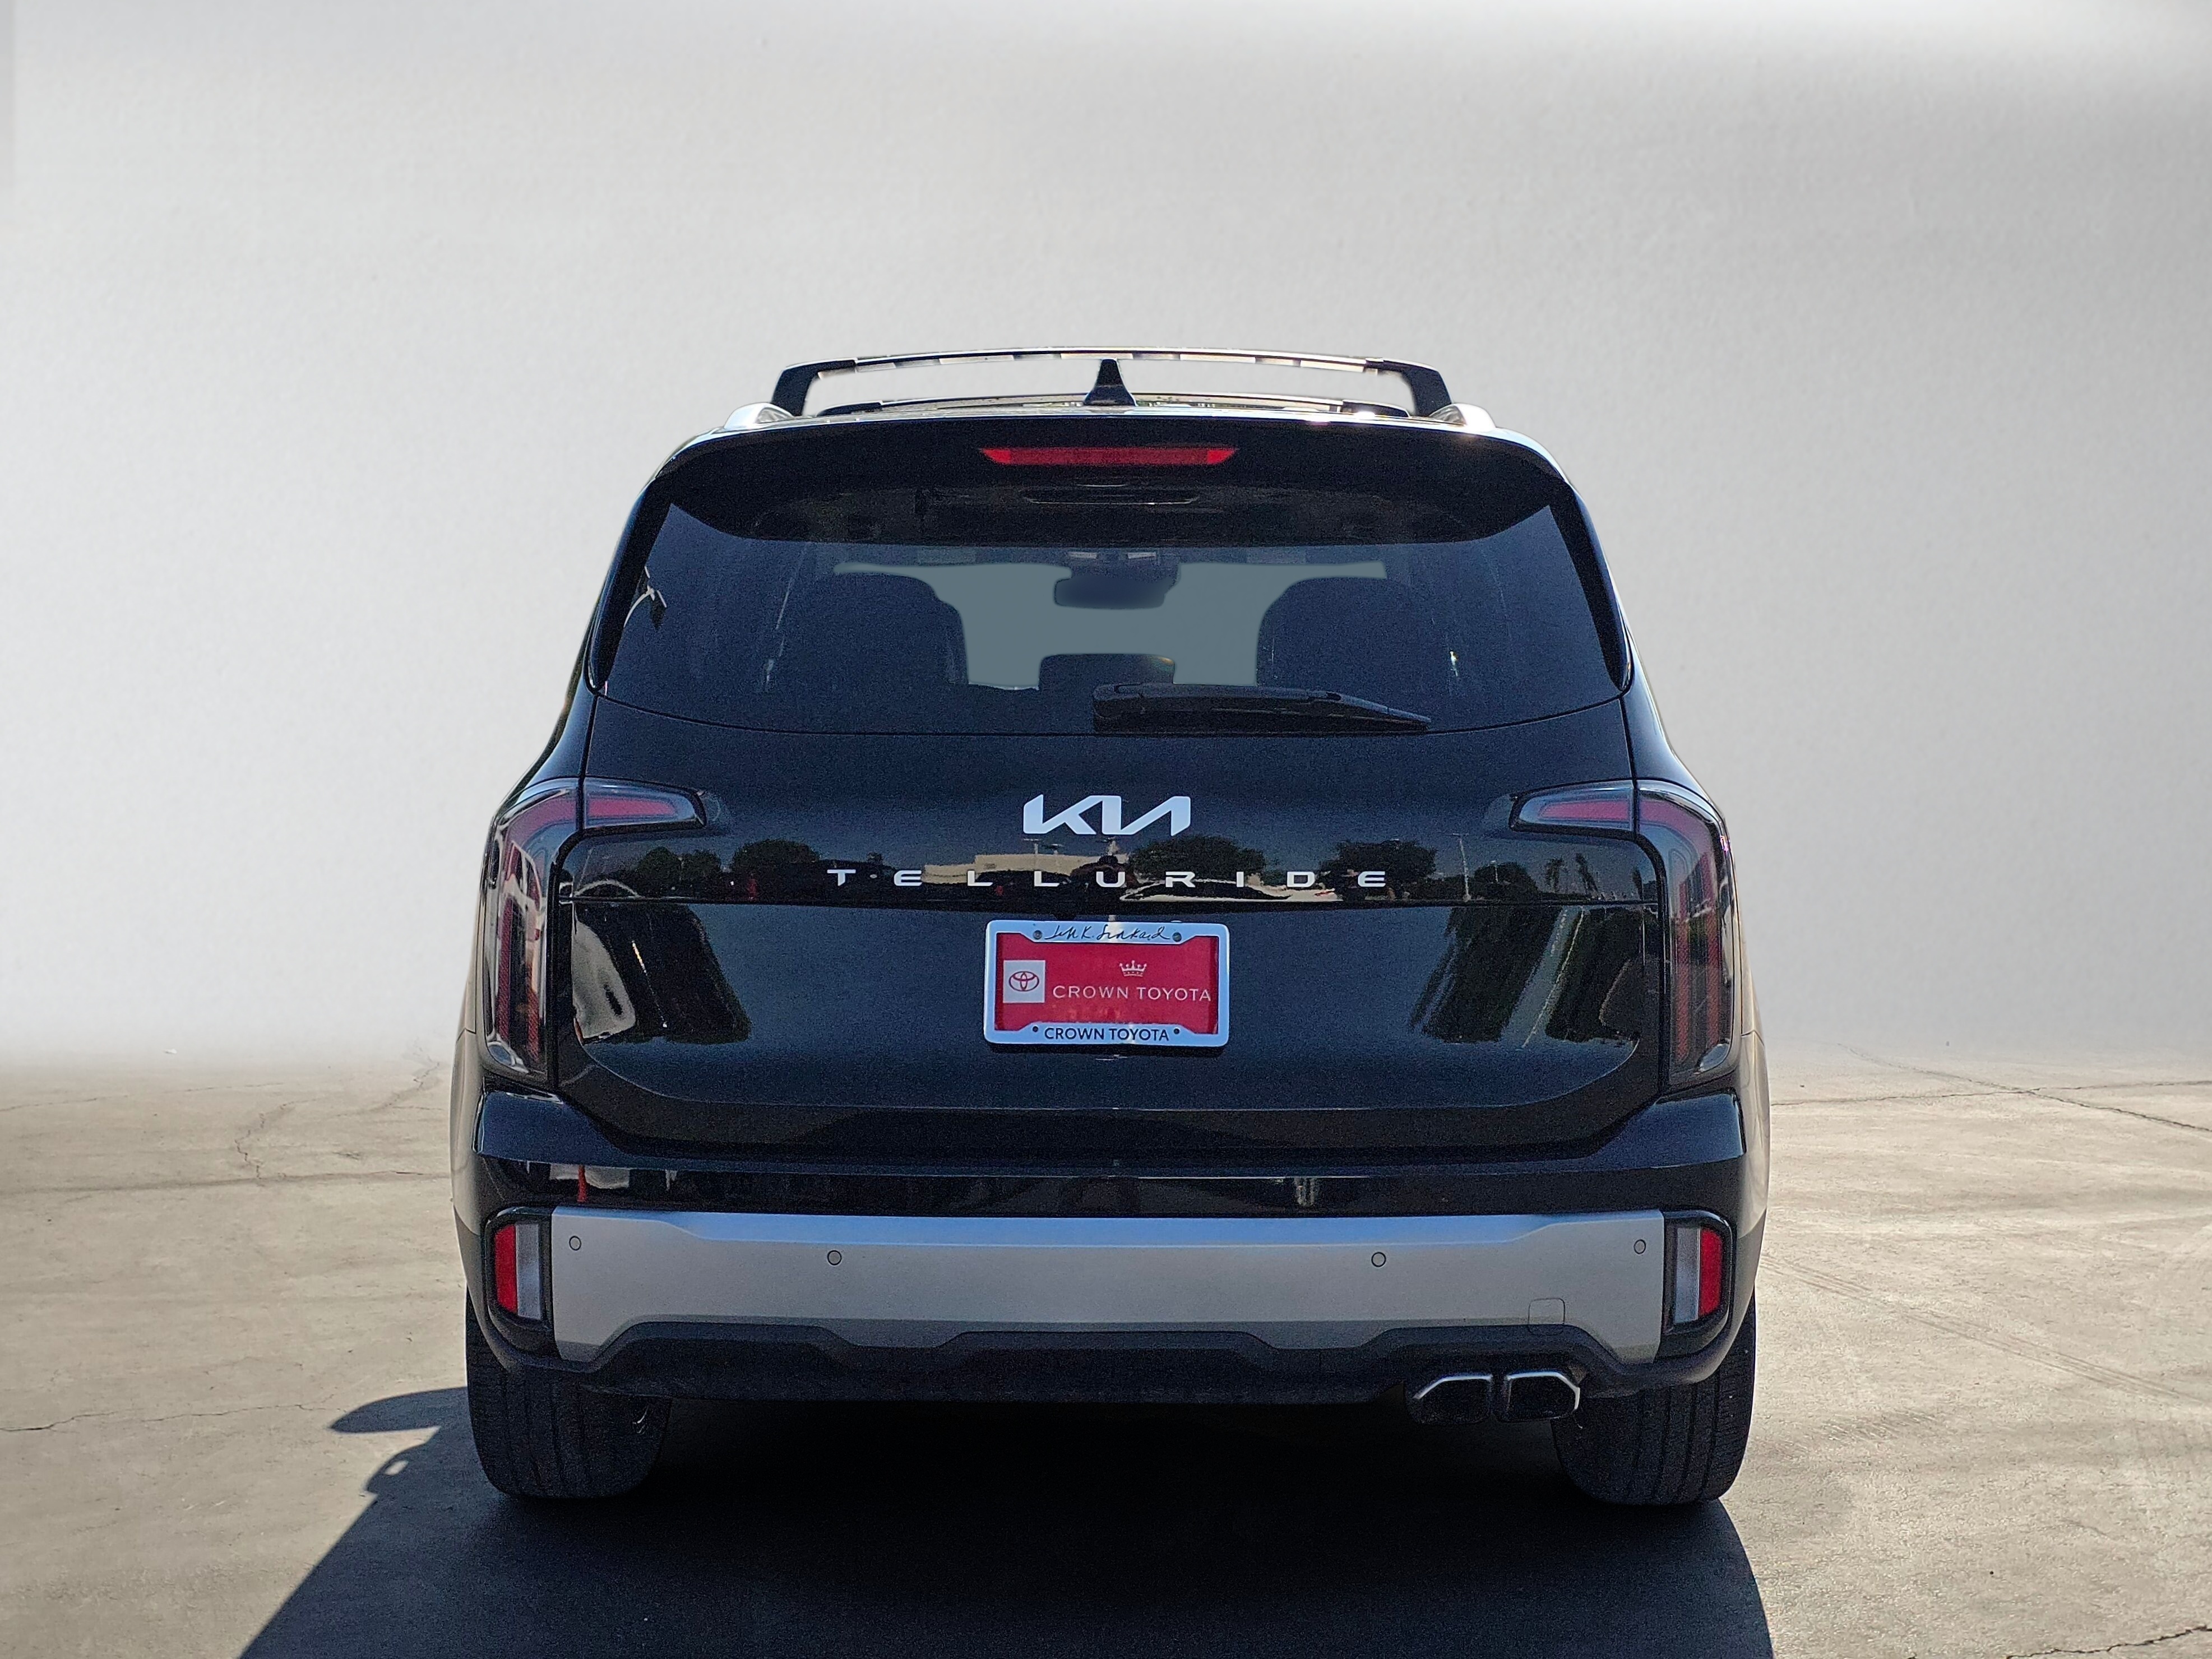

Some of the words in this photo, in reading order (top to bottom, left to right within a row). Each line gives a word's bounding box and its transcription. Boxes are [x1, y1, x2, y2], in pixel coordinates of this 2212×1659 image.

[1023, 795, 1191, 836] KIA
[827, 869, 1386, 888] TELLURIDE
[1053, 985, 1128, 999] CROWN
[1137, 987, 1211, 1002] TOYOTA
[1044, 1027, 1104, 1039] CROWN
[1109, 1029, 1169, 1041] TOYOTA
